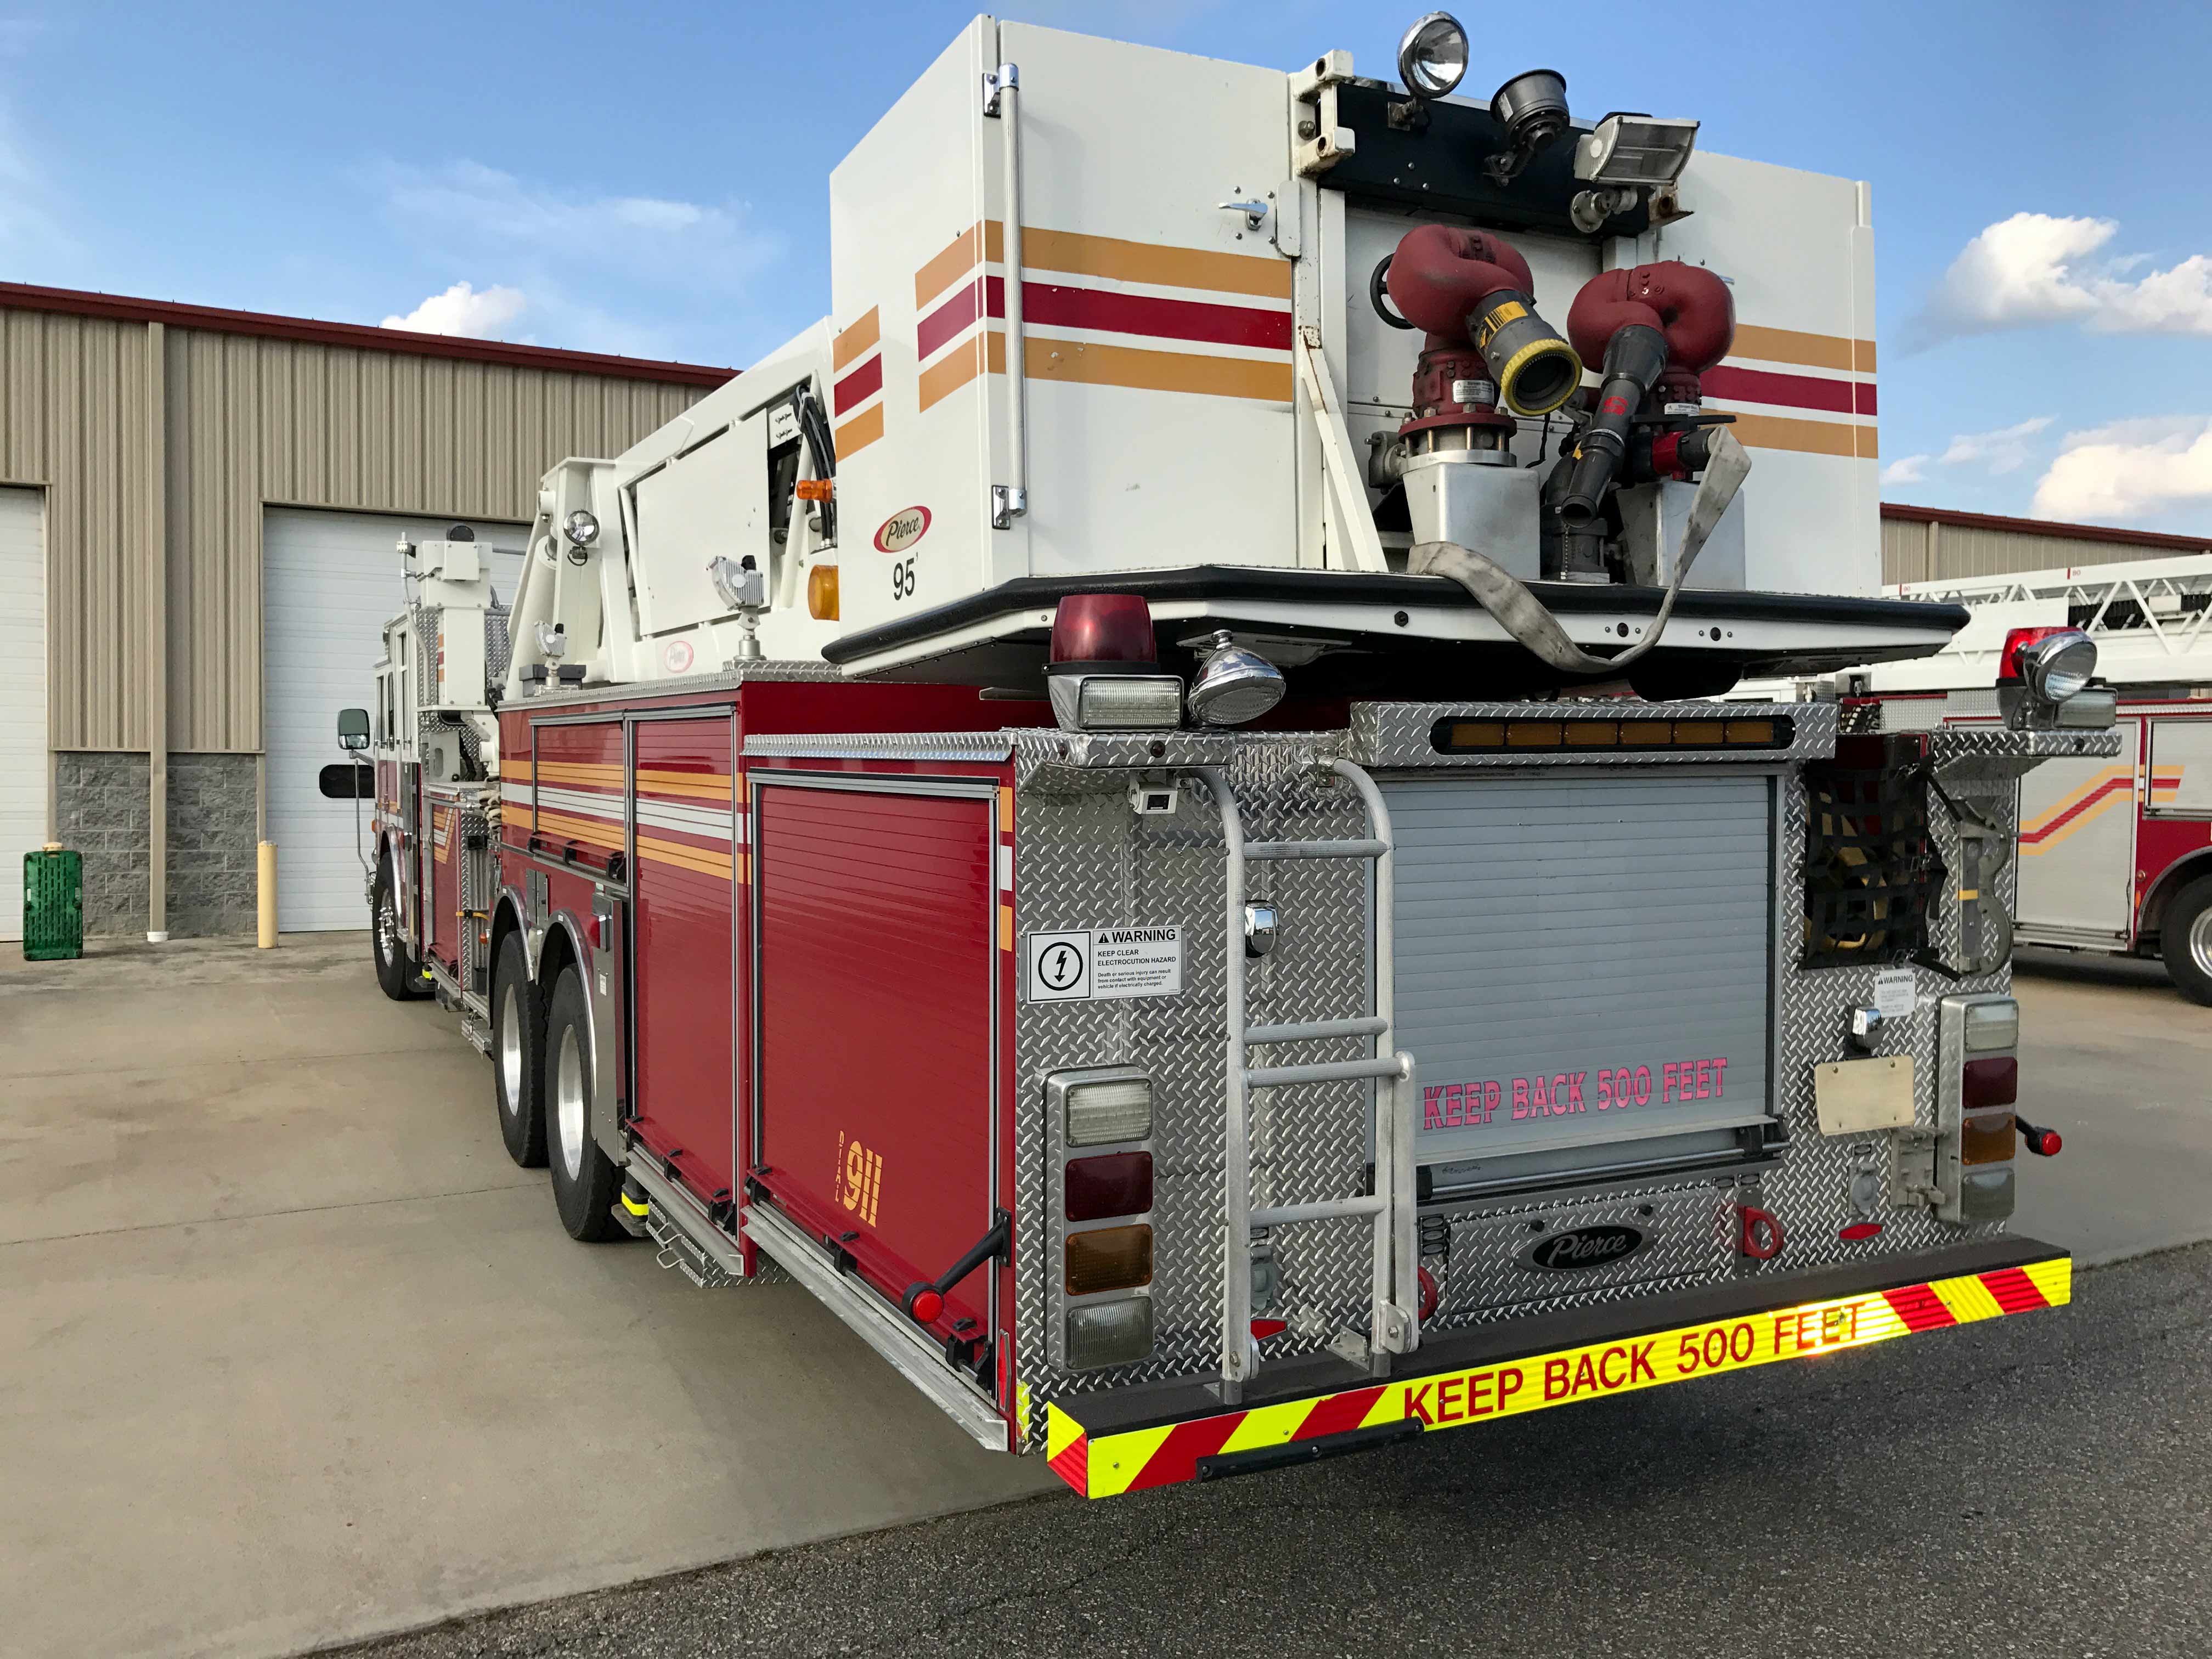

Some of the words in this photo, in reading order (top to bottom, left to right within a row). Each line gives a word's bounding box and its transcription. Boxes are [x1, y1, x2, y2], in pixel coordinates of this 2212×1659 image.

[885, 517, 919, 546] Pierce
[1111, 928, 1176, 943] WARNING
[1098, 958, 1149, 966] ELECTROCUTION
[1883, 974, 1913, 984] WARNING
[1423, 1080, 1501, 1130] KEEP
[1510, 1071, 1588, 1121] BACK
[1597, 1065, 1651, 1111] 500
[1662, 1057, 1728, 1104] FEET
[843, 1141, 883, 1228] 911
[1547, 1234, 1627, 1268] Pierce
[1404, 1368, 1523, 1426] KEEP
[1544, 1341, 1657, 1401] BACK
[1677, 1323, 1755, 1374] 500
[1774, 1302, 1866, 1355] FEET
